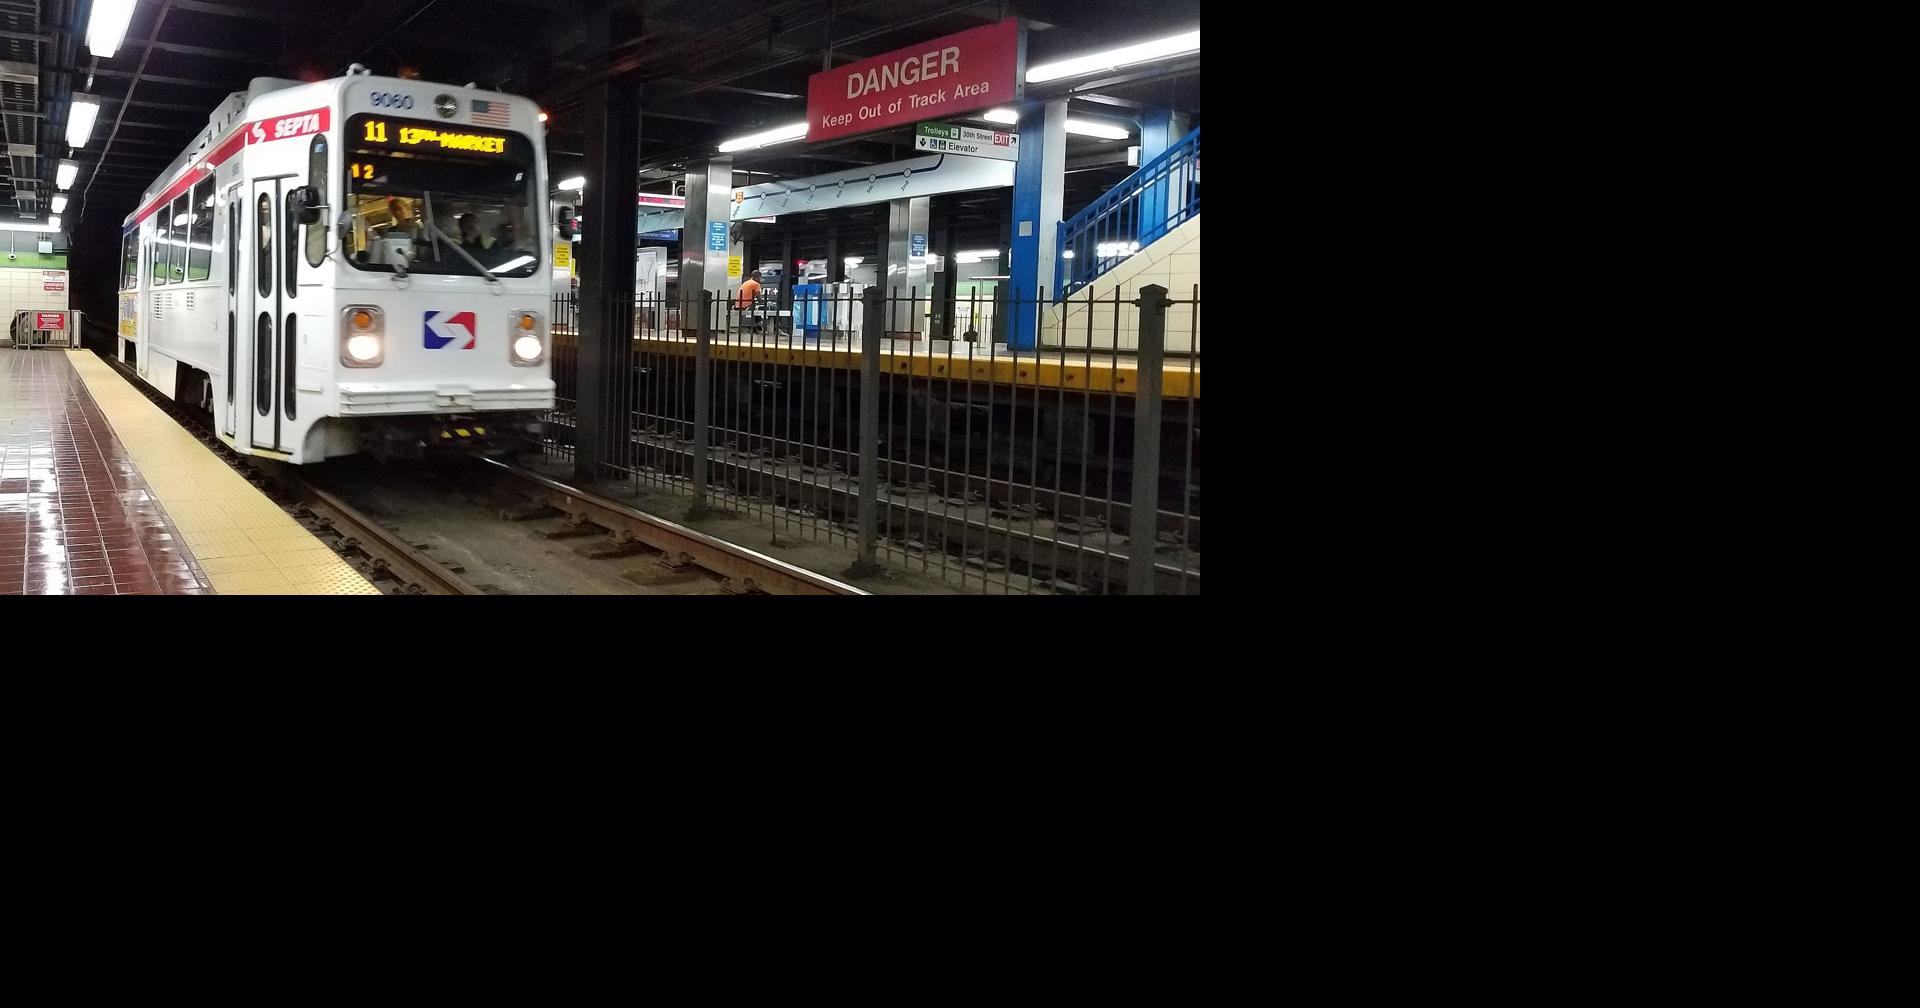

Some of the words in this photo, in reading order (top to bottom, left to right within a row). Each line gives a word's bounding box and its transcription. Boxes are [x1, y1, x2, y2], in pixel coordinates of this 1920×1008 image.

[847, 46, 961, 99] DANGER
[370, 91, 414, 110] 9060
[822, 113, 853, 129] Keep
[859, 104, 882, 121] Out
[888, 99, 902, 115] of
[908, 90, 946, 110] Track
[953, 80, 990, 101] Area
[274, 112, 320, 139] SEPTA
[364, 120, 388, 143] 11
[924, 126, 949, 137] Trolleys
[962, 131, 976, 139] 30th
[976, 132, 993, 141] Street
[994, 135, 1009, 145] EXIT
[948, 142, 979, 154] Elevator
